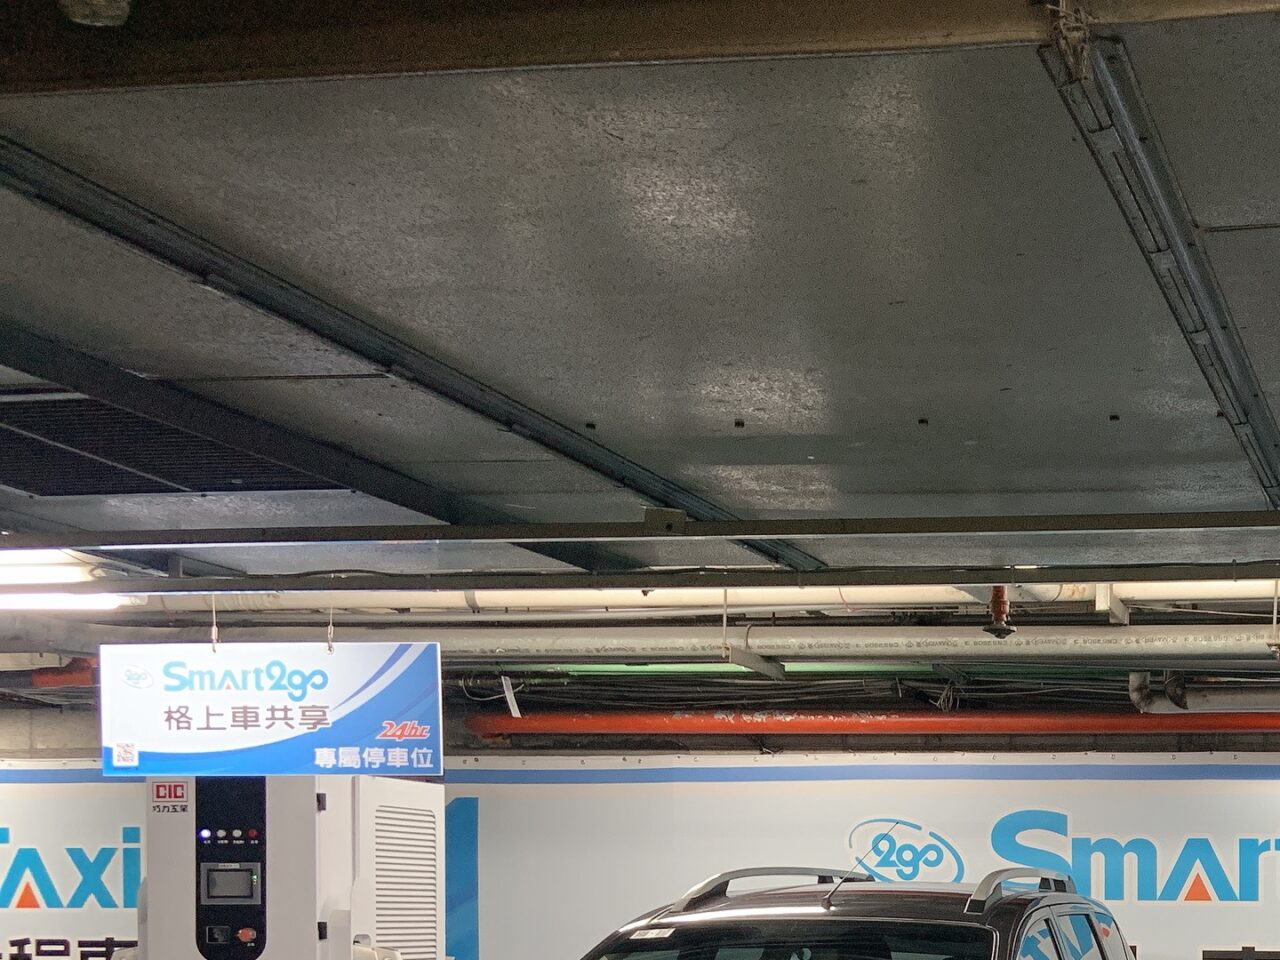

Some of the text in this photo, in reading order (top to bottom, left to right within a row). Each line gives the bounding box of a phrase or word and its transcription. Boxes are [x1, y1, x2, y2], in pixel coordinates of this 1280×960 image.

[163, 705, 330, 731] 格上車共享
[375, 720, 431, 742] 24hr
[314, 746, 434, 769] 專屬停車位
[156, 785, 184, 798] CIC
[872, 832, 944, 881] 2go
